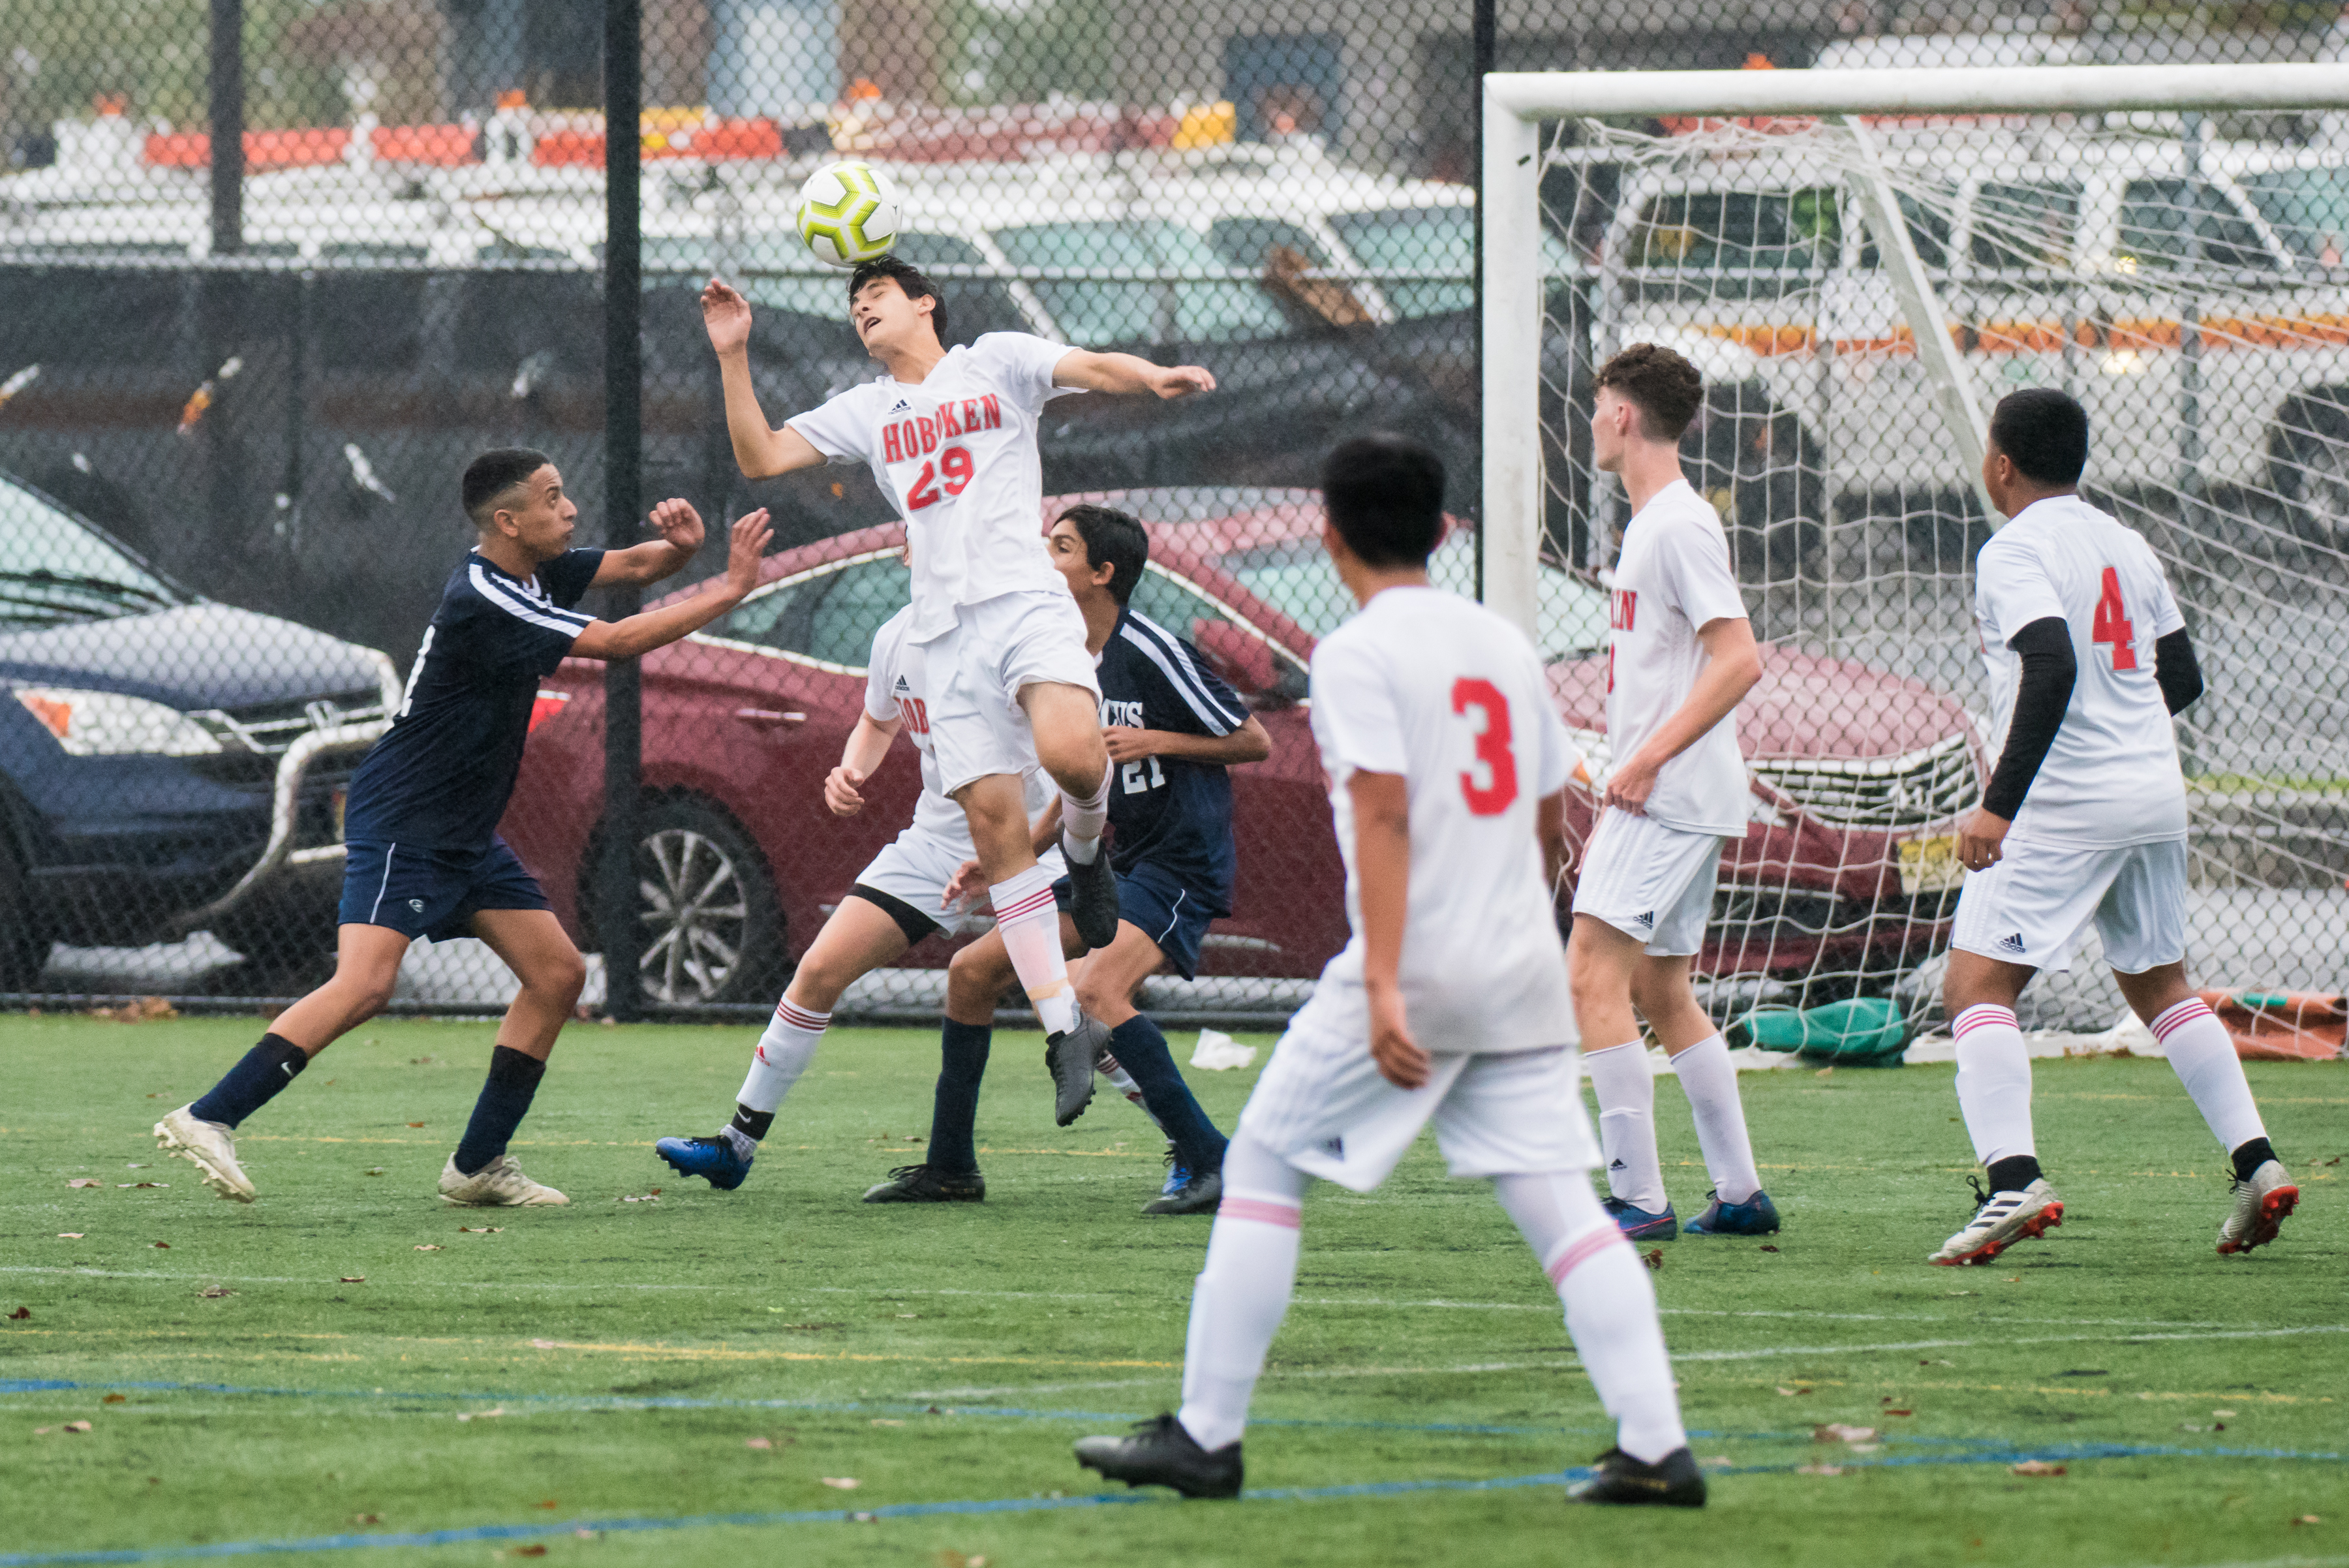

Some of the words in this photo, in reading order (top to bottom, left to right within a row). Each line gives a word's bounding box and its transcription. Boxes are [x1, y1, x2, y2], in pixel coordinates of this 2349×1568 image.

[907, 445, 975, 512] 29
[2092, 566, 2138, 671] 4
[1122, 755, 1166, 794] 21
[1451, 677, 1518, 816] 3
[1999, 940, 2026, 953] adidas
